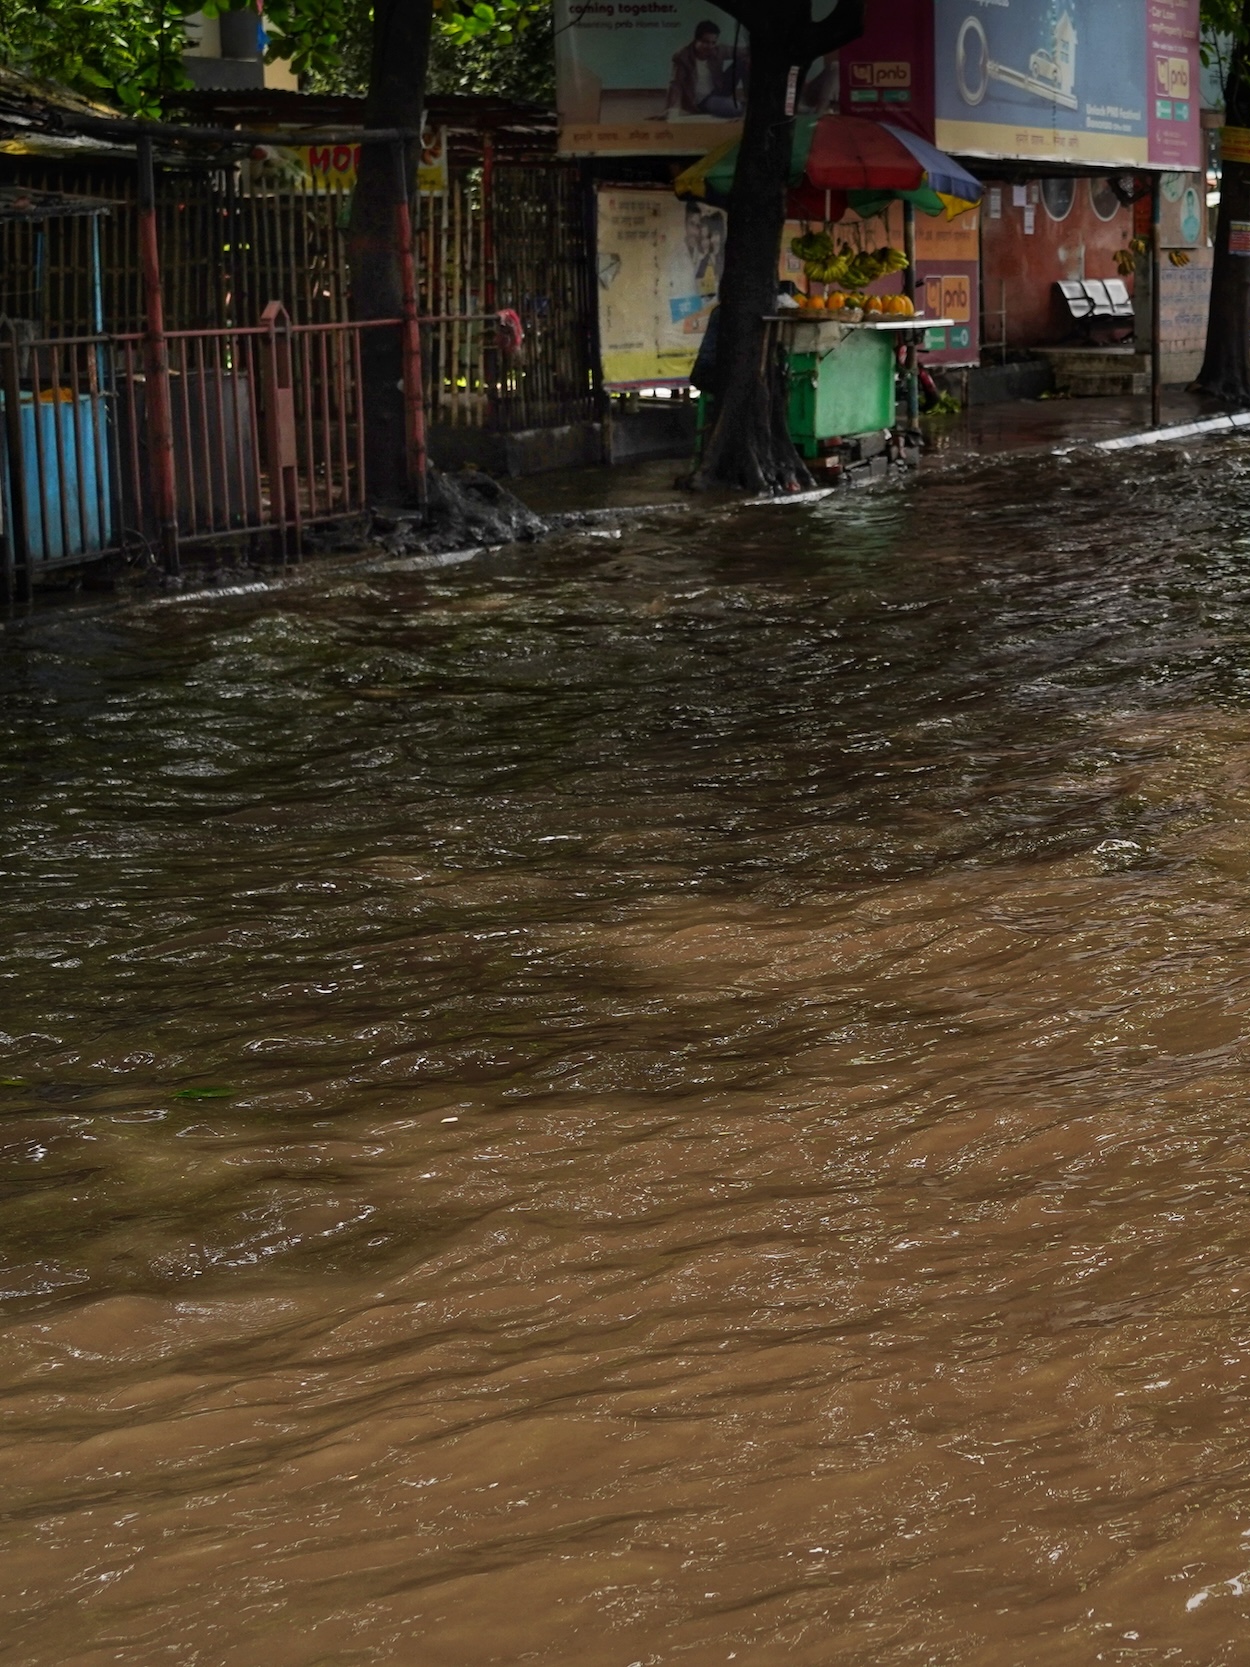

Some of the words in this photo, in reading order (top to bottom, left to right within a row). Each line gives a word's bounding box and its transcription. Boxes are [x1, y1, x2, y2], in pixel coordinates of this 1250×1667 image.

[569, 2, 614, 16] coming
[618, 2, 677, 16] together.
[877, 65, 907, 83] pnb
[1171, 65, 1187, 91] pnb
[943, 282, 967, 315] pnb
